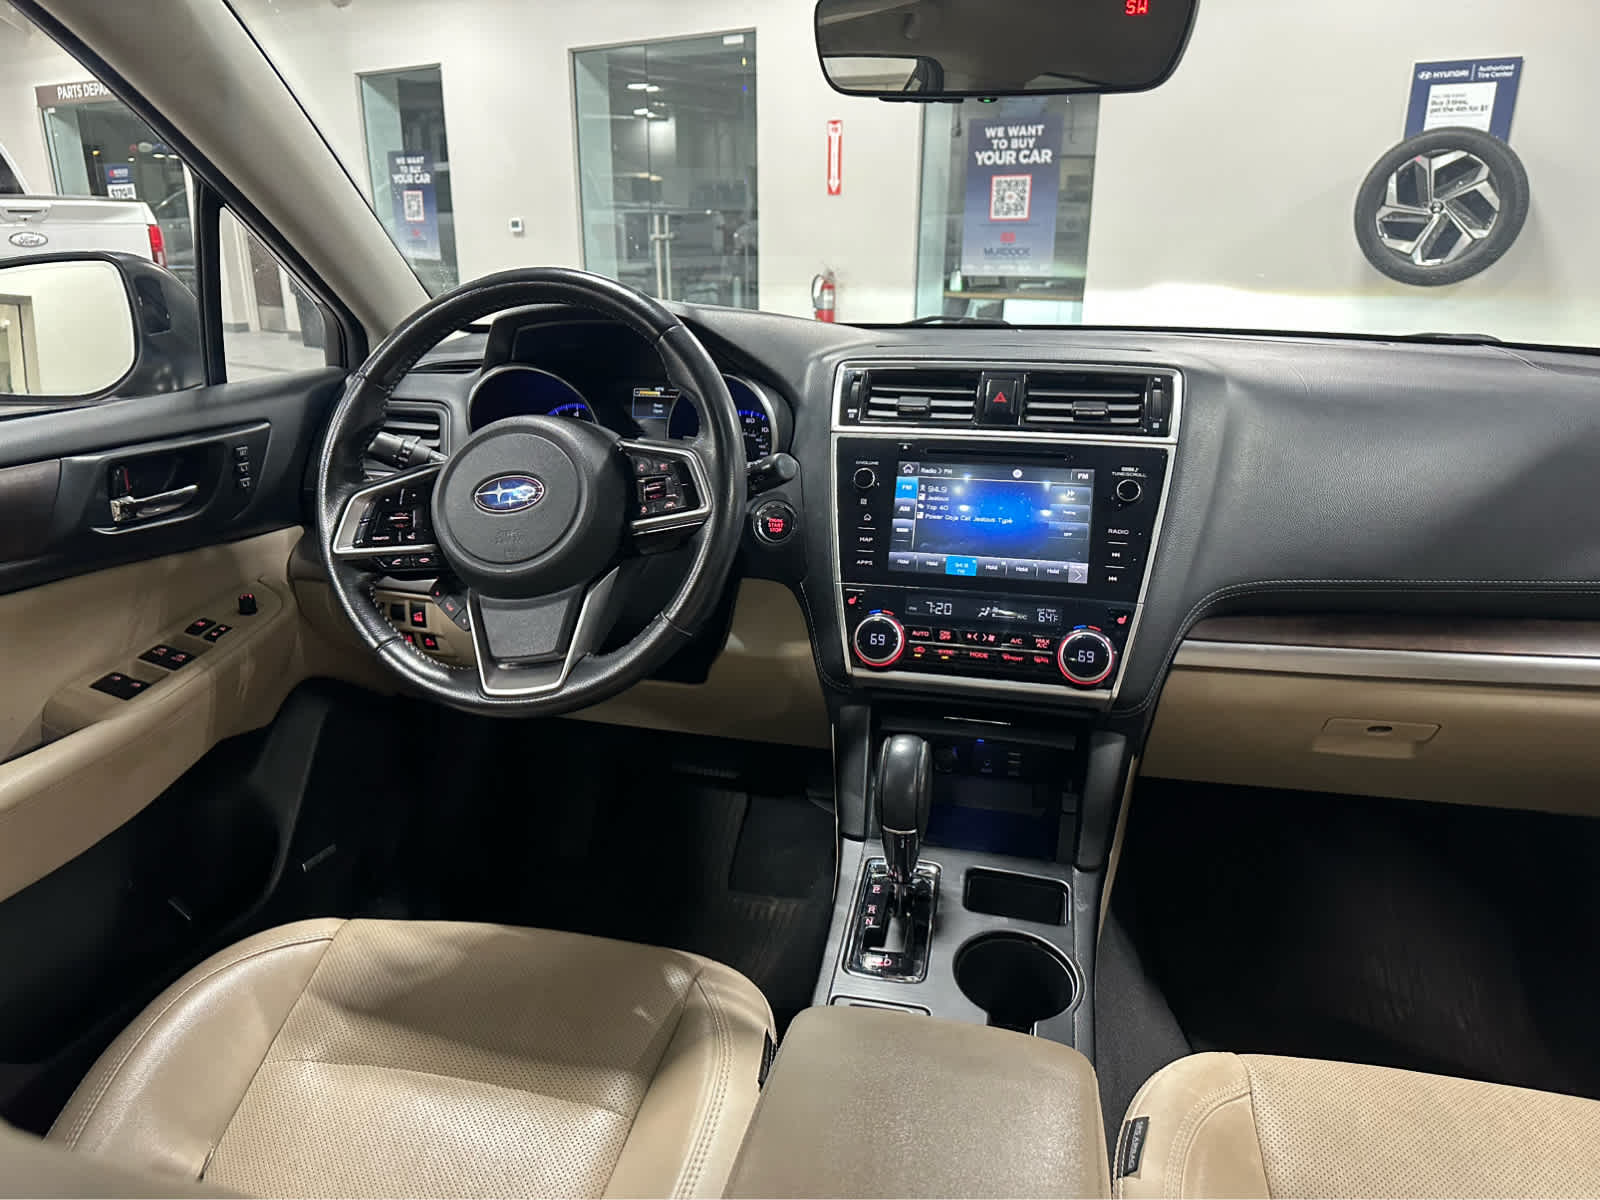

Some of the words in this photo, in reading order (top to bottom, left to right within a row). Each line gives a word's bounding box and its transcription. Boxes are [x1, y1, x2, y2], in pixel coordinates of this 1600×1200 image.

[1125, 0, 1149, 14] SW
[1433, 70, 1469, 78] HYUNDAI
[57, 84, 82, 100] PARTS
[985, 127, 1004, 138] WE
[1008, 125, 1044, 136] WANT
[992, 139, 1008, 149] TO
[1010, 138, 1036, 149] BUY
[975, 151, 1016, 165] YOUR
[1018, 150, 1052, 164] CAR
[392, 174, 413, 184] YOUR
[414, 173, 431, 184] CAR
[927, 485, 948, 494] 94.9
[925, 601, 953, 615] 7:20
[870, 633, 886, 646] 69
[969, 651, 989, 659] MODE
[1078, 650, 1095, 664] 69
